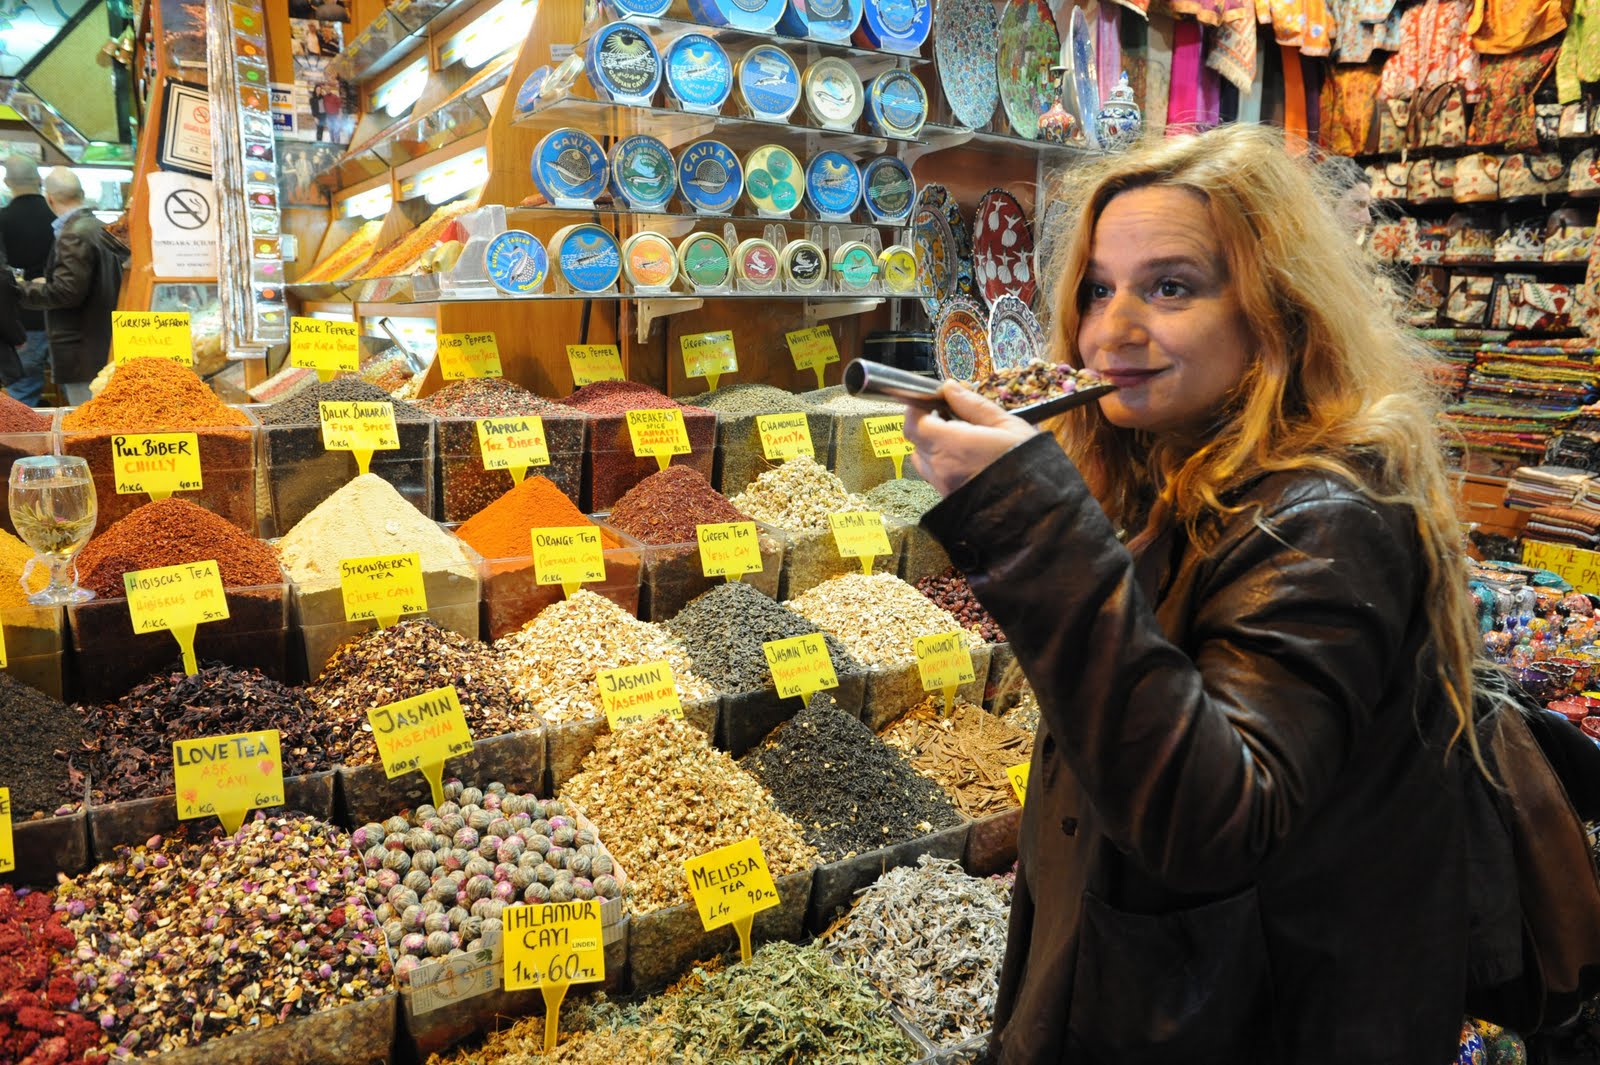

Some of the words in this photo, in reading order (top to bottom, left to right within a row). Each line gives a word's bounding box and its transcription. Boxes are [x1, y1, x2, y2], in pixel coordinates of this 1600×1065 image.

[553, 137, 599, 164] CAVIAR
[684, 146, 735, 172] CAVIAR
[114, 314, 151, 328] TURKISH
[293, 321, 322, 334] BLACK
[325, 321, 357, 336] PEPPER
[465, 334, 493, 346] PEPPER
[789, 334, 810, 345] WHITE
[570, 348, 587, 360] RED
[589, 346, 614, 358] PEPPER
[320, 404, 351, 422] BALIK
[629, 410, 678, 426] BREAKFAST
[330, 422, 354, 432] FISH
[363, 422, 392, 432] SPICE
[482, 419, 530, 436] PAPRICA
[764, 430, 805, 446] PAPATYA
[114, 436, 142, 457] PUL
[124, 457, 176, 474] CHILLY
[179, 481, 191, 490] 40
[830, 514, 865, 529] LEMON
[536, 534, 574, 547] ORANGE
[576, 532, 597, 544] TEA
[702, 528, 729, 543] GREEN
[729, 525, 749, 538] TEA
[342, 557, 413, 578] STRAWBERRY
[129, 572, 182, 592] HIBISCUS
[185, 566, 213, 580] TEA
[368, 571, 395, 581] TEA
[402, 604, 414, 613] 80
[766, 646, 801, 665] JASMIN
[798, 639, 818, 655] TEA
[604, 668, 662, 693] JASMIN
[374, 696, 452, 734] JASMIN
[176, 743, 228, 767] LOVE
[230, 737, 269, 759] TEA
[448, 744, 463, 754] 40
[255, 792, 270, 806] 60
[691, 857, 760, 891] MELISSA
[720, 880, 746, 895] TEA
[747, 889, 763, 904] 90
[507, 901, 597, 932] IHLAMUR
[523, 928, 569, 950] ÇAYI
[572, 941, 596, 949] LINDEN
